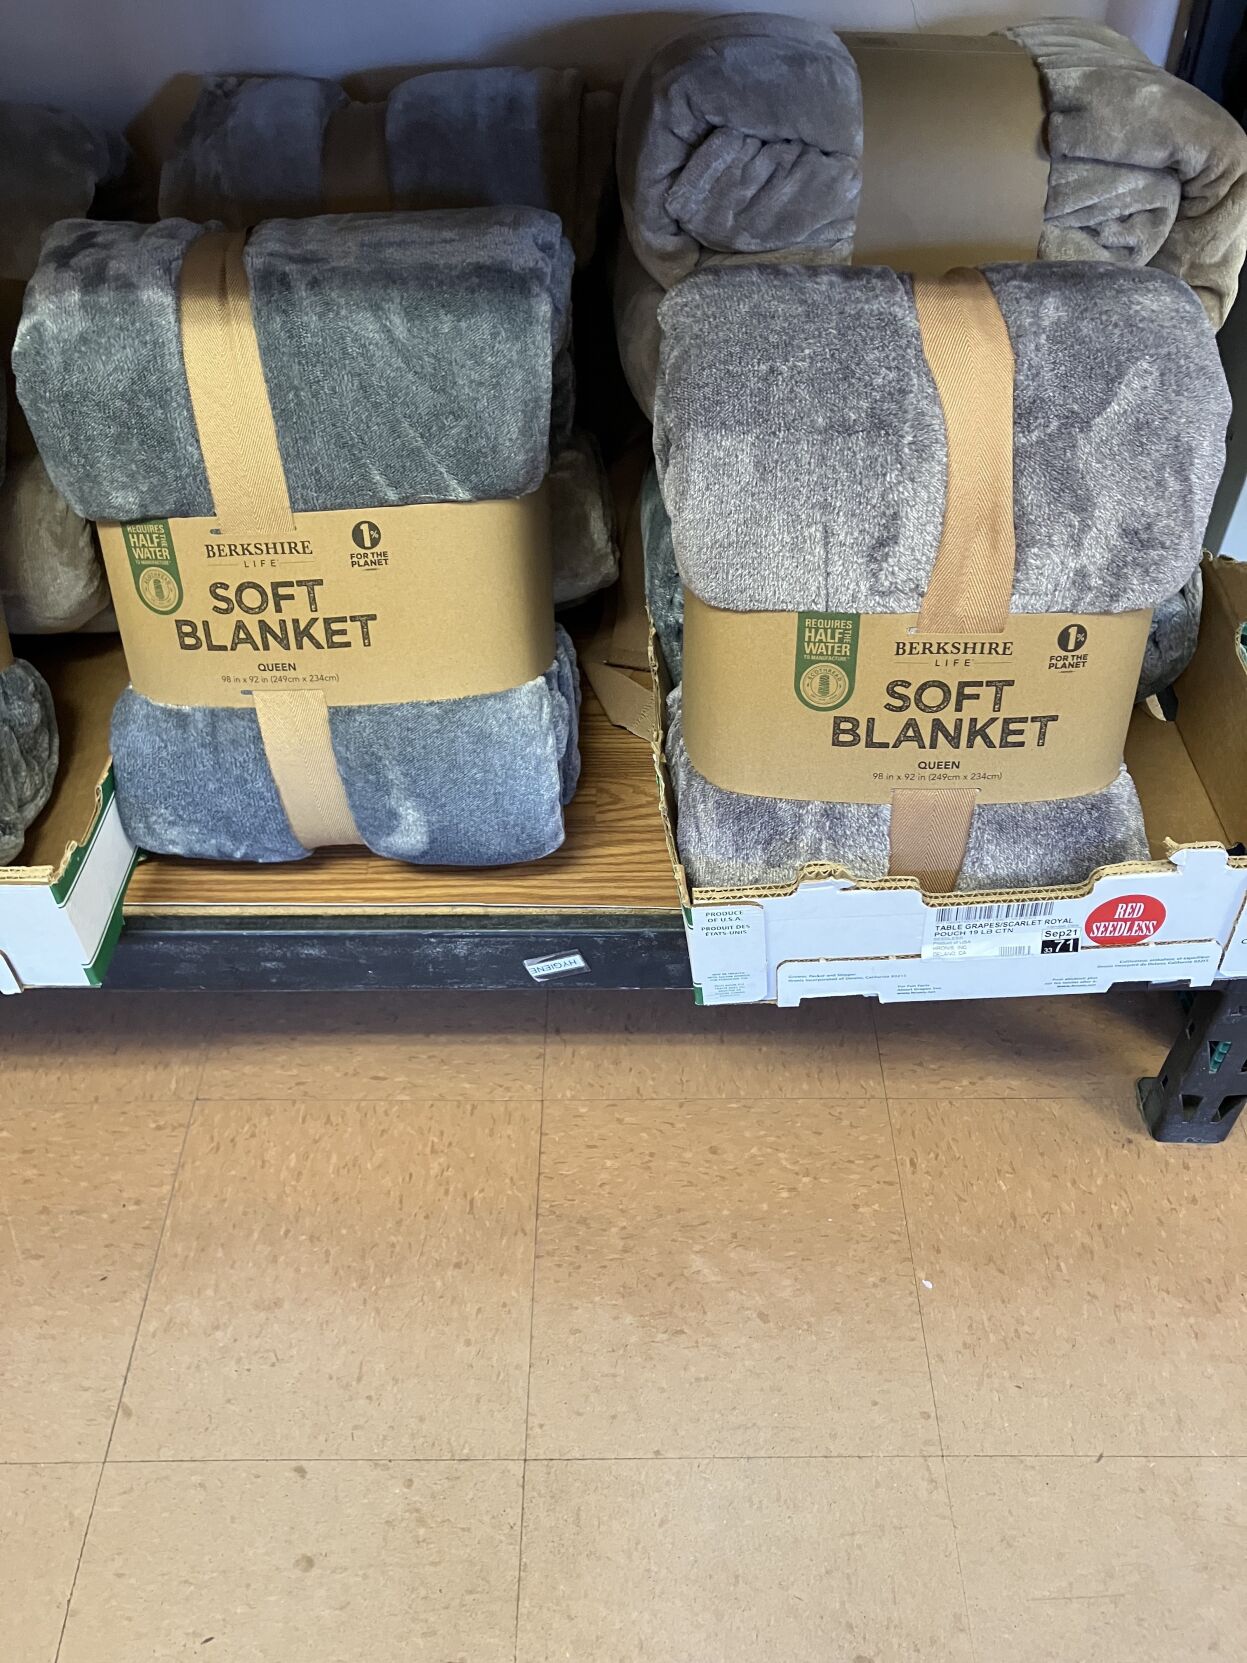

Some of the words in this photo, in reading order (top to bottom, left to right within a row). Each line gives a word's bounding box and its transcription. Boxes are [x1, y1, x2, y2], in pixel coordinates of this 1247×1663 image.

[127, 524, 165, 534] REQUIRES
[128, 533, 160, 547] HALF
[131, 547, 170, 560] WATER
[204, 540, 313, 559] BERKSHIRE
[350, 552, 369, 560] FOR
[370, 551, 389, 559] THE
[243, 560, 277, 569] LIFE
[351, 558, 389, 568] PLANET
[208, 578, 324, 615] SOFT
[805, 618, 852, 629] REQUIRES
[174, 613, 377, 652] BLANKET
[804, 628, 843, 642] HALF
[844, 630, 852, 643] THE
[804, 642, 850, 656] WATER
[894, 641, 1014, 656] BERKSHIRE
[934, 658, 972, 667] LIFE
[1049, 655, 1069, 663] FOR
[1070, 654, 1089, 662] THE
[257, 662, 297, 672] QUEEN
[1048, 661, 1088, 670] PLANET
[221, 675, 232, 683] 98
[233, 675, 240, 683] in
[249, 675, 259, 683] 92
[261, 675, 268, 683] in
[270, 674, 299, 684] (249cm
[309, 673, 340, 684] 234cm)
[883, 679, 1015, 713] SOFT
[831, 714, 1059, 750] BLANKET
[917, 761, 960, 771] QUEEN
[872, 773, 884, 781] 98
[886, 773, 894, 781] in
[904, 773, 916, 781] 92
[917, 773, 926, 781] in
[928, 772, 961, 783] (249cm
[970, 772, 1002, 782] 234cm)
[1114, 902, 1145, 919] RED
[965, 920, 1041, 930] GRAPES/SCARLET
[1090, 921, 1157, 938] SEEDLESS
[1044, 929, 1078, 939] Sep21
[530, 959, 577, 975] HYGIENE
